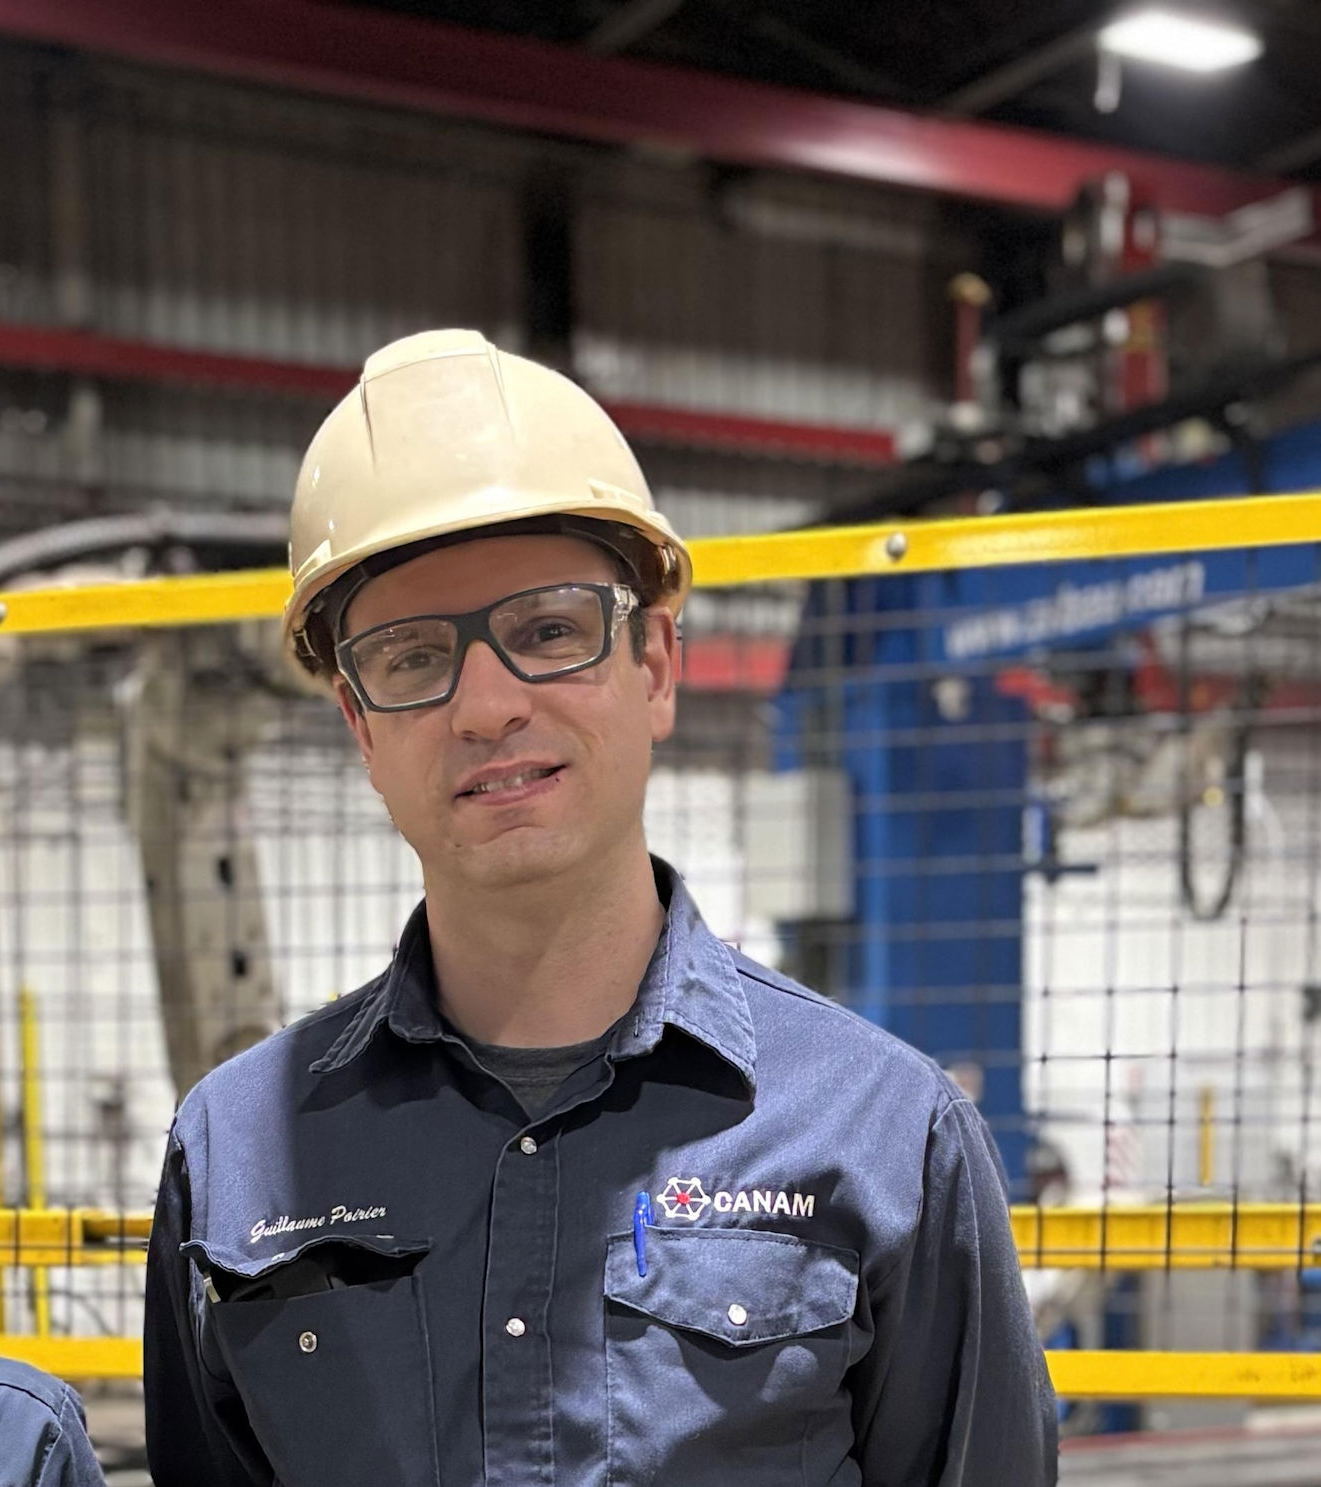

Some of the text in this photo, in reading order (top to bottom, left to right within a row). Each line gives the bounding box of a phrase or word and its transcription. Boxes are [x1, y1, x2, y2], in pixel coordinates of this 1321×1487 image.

[713, 1190, 815, 1218] CANAM
[249, 1205, 387, 1244] Guillaume Poirier
